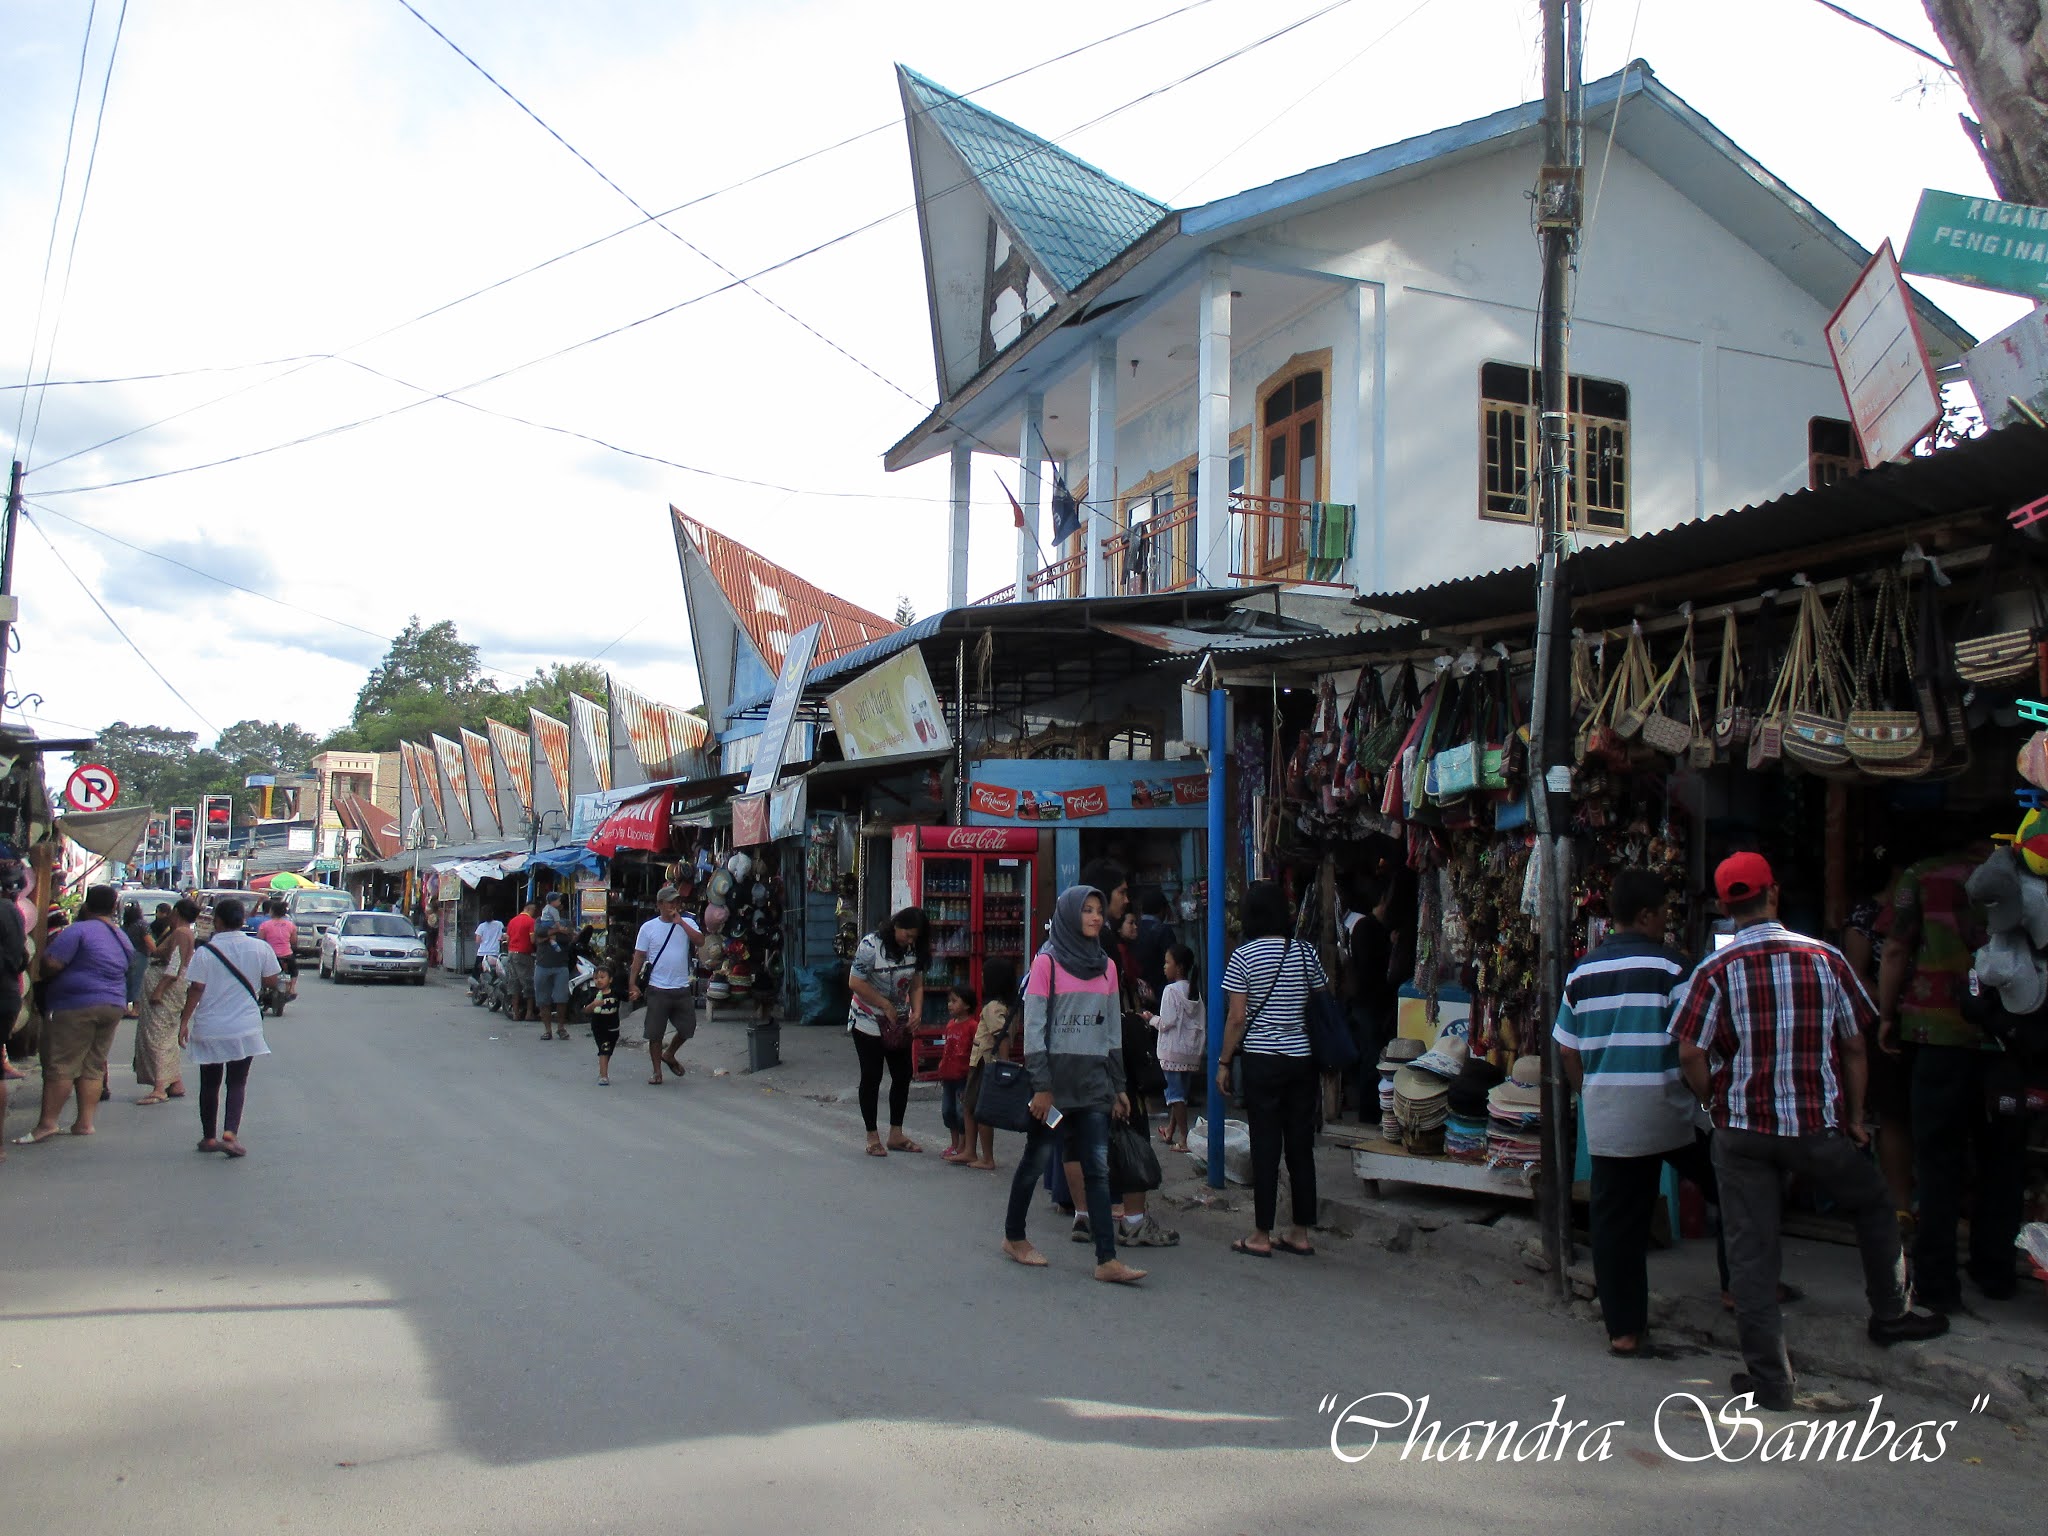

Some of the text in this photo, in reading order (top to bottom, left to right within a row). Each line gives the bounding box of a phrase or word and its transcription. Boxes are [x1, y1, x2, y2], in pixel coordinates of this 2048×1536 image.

[1932, 226, 2048, 264] PENGINA
[947, 827, 1009, 849] Coca-Cola
[1061, 1014, 1091, 1026] LIKE
